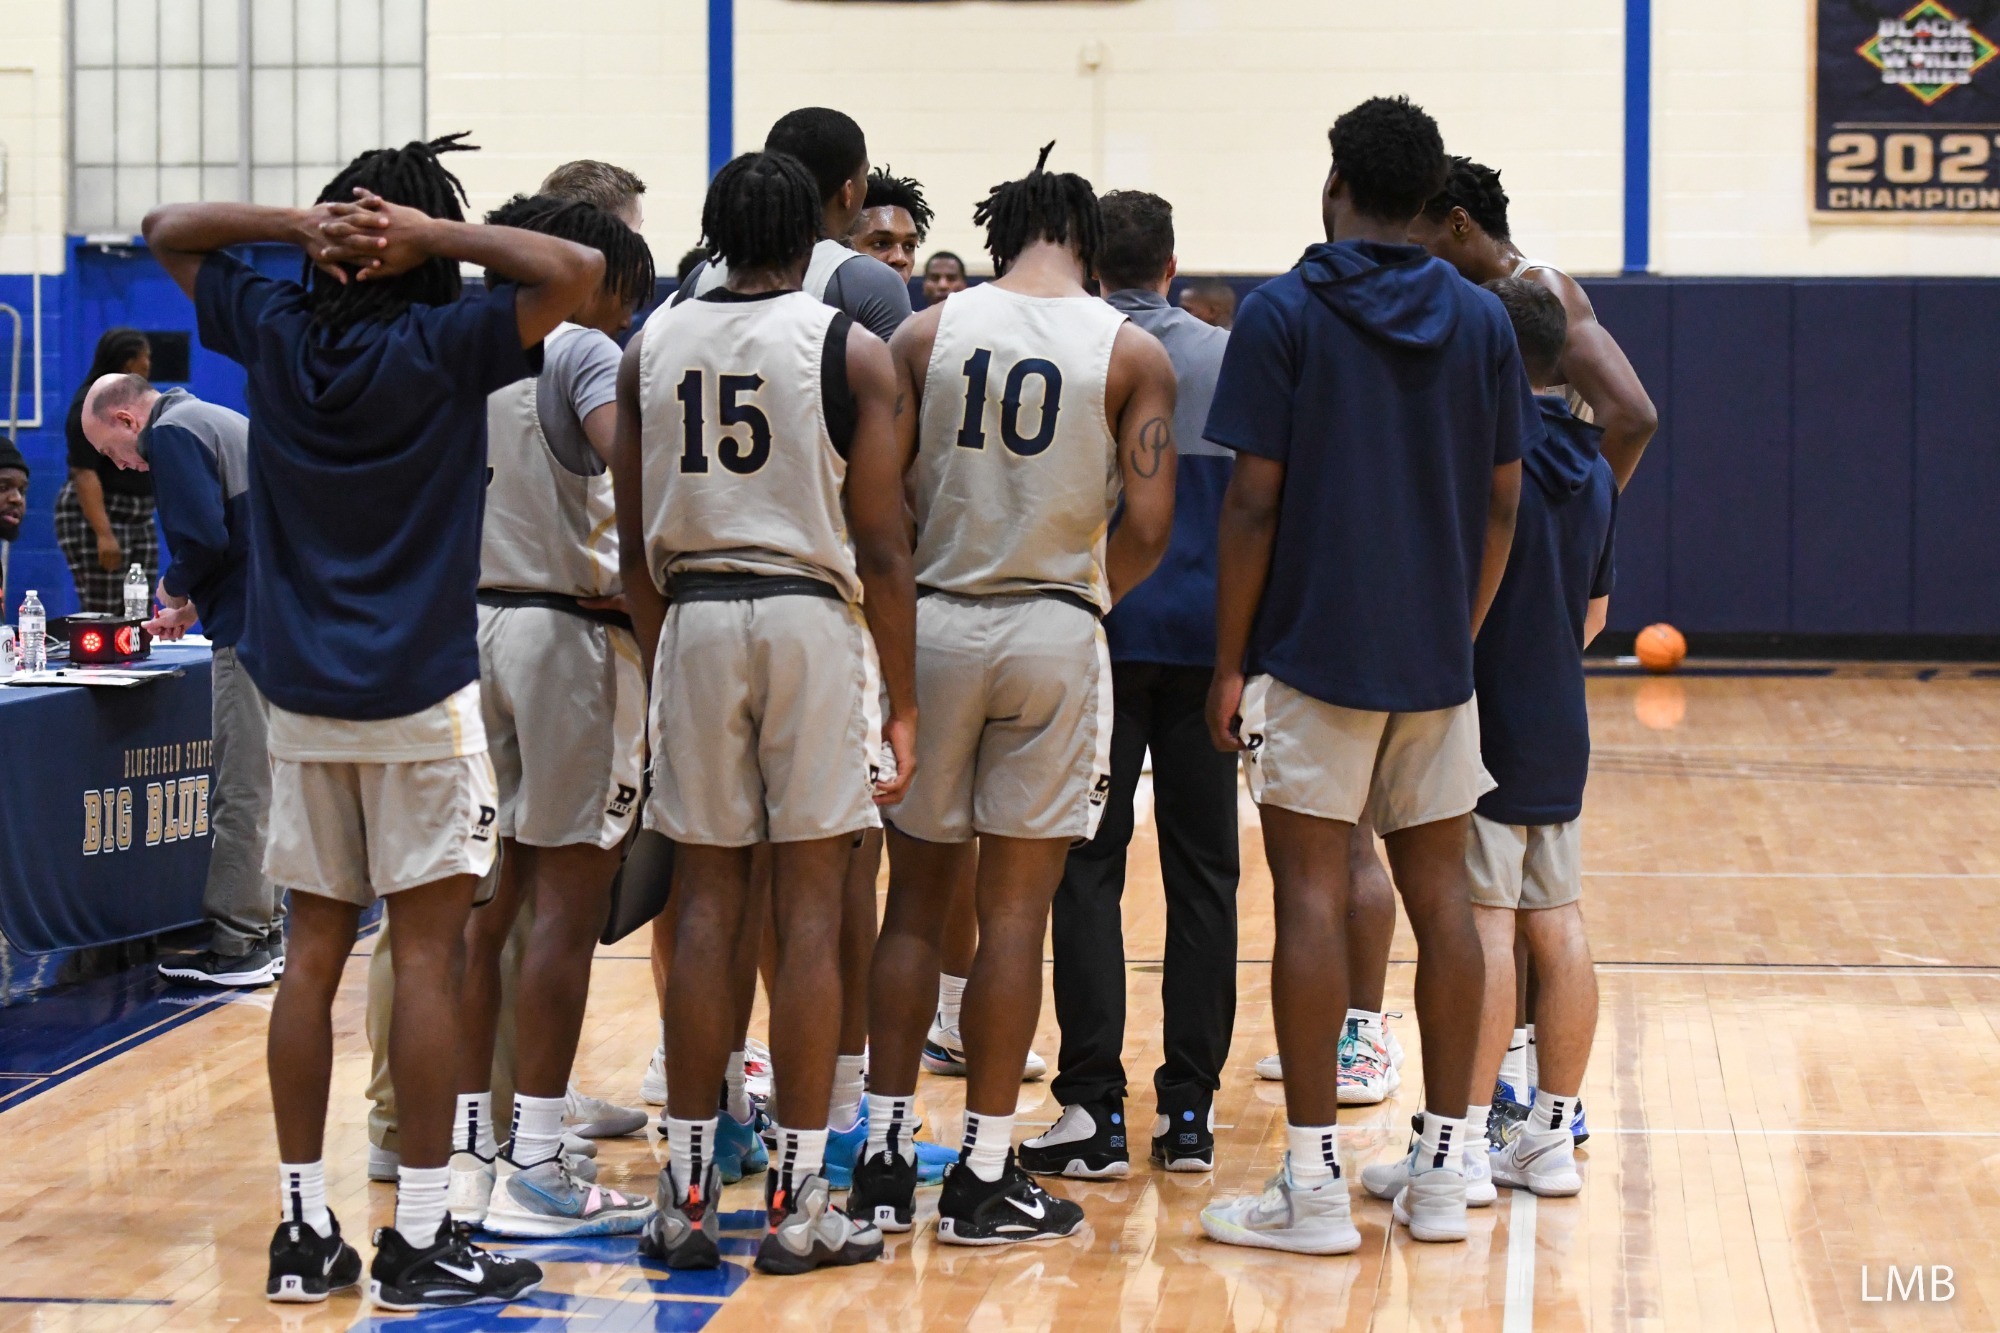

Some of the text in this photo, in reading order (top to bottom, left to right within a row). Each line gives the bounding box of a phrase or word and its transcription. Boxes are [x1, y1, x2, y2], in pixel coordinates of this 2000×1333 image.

[1827, 132, 2000, 184] 202
[676, 369, 772, 475] 15
[956, 347, 1062, 457] 10
[124, 740, 213, 779] BLUEFIELD STATE
[83, 774, 210, 856] BIG BLUE
[609, 801, 633, 814] STATE
[1180, 1133, 1198, 1145] 23
